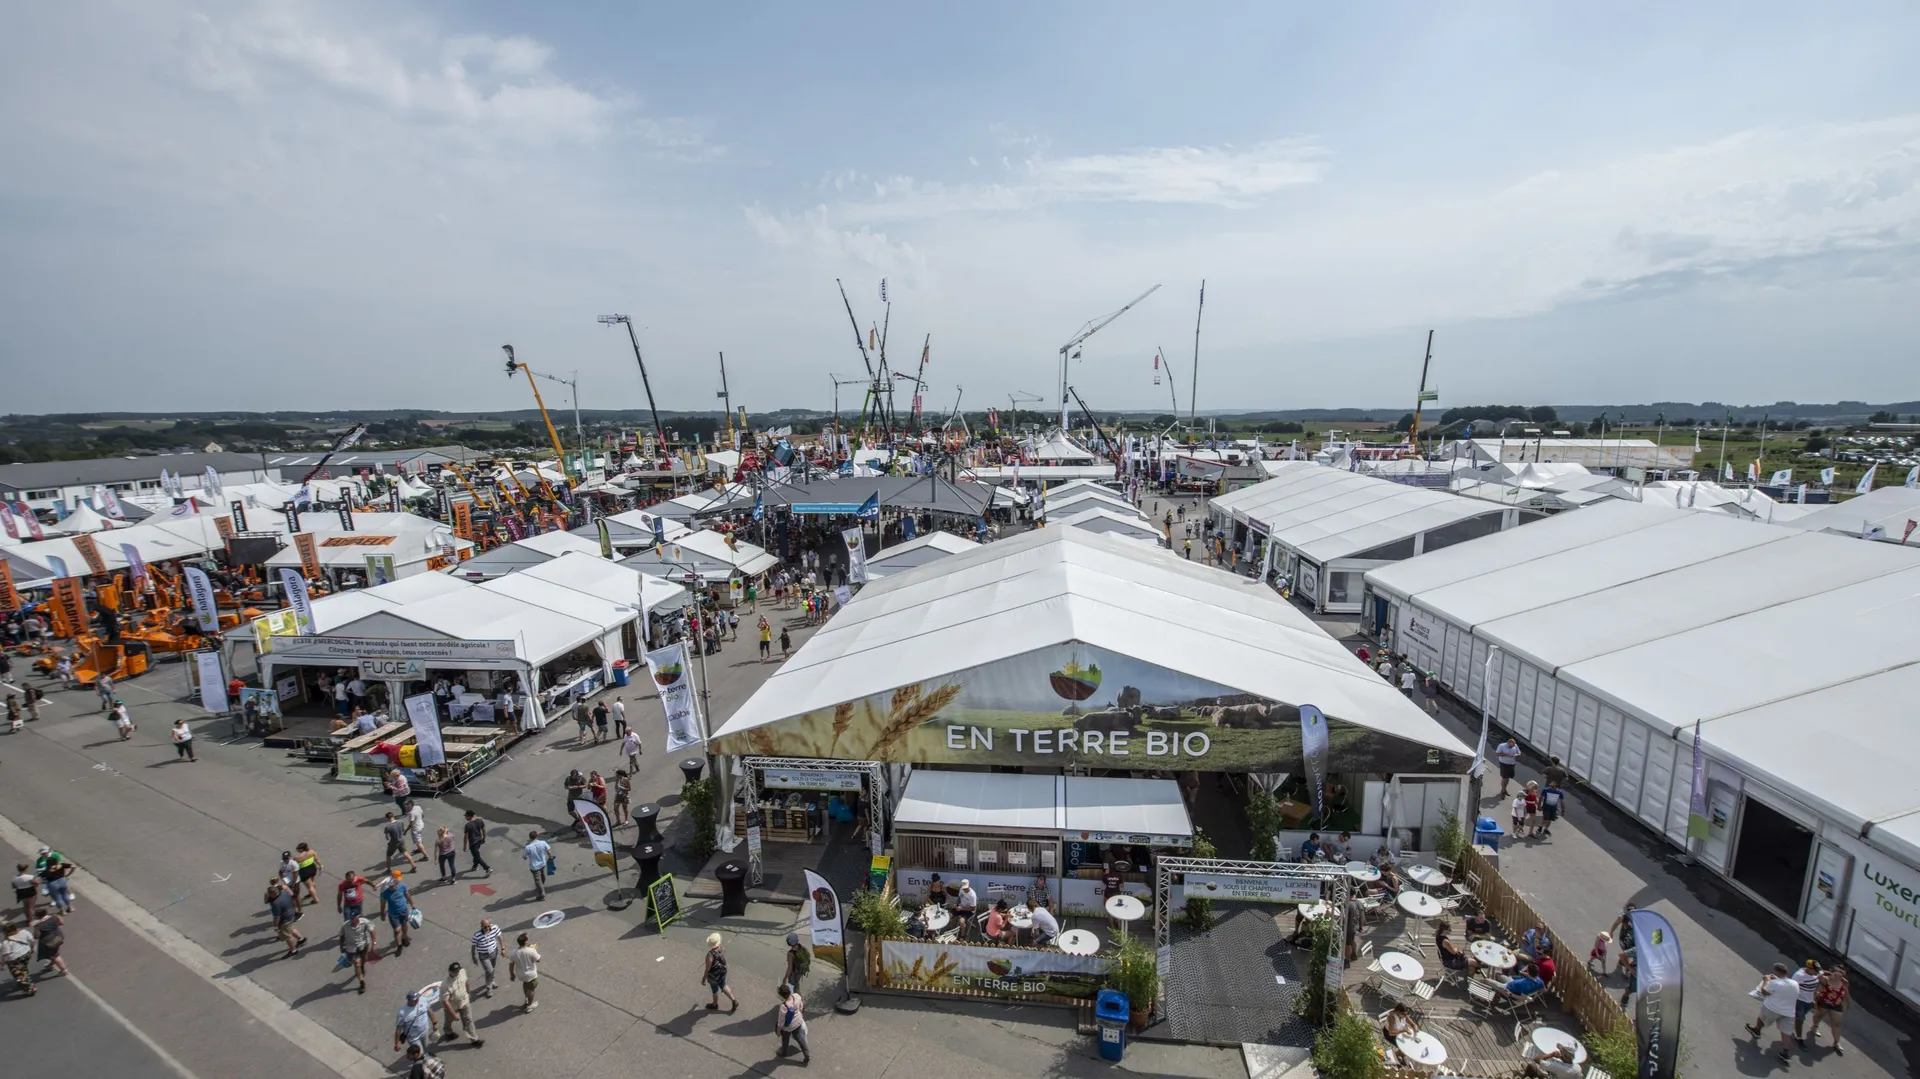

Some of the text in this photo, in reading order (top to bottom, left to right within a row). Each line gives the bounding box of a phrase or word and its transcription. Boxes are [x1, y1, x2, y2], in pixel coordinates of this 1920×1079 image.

[192, 575, 208, 611] natagora
[288, 575, 304, 613] natagora
[389, 640, 399, 648] qui
[436, 640, 459, 648] modèle
[461, 641, 485, 649] agricole
[328, 646, 355, 654] Citoyens
[362, 660, 420, 675] FUGEA
[667, 683, 687, 694] terre
[947, 725, 1211, 757] EN TERRE BIO
[908, 877, 921, 886] En
[1235, 878, 1269, 886] BIENVENUE
[1003, 882, 1026, 892] terre
[1248, 885, 1283, 893] CHAPITEAU
[953, 975, 1046, 993] EN TERRE BIO
